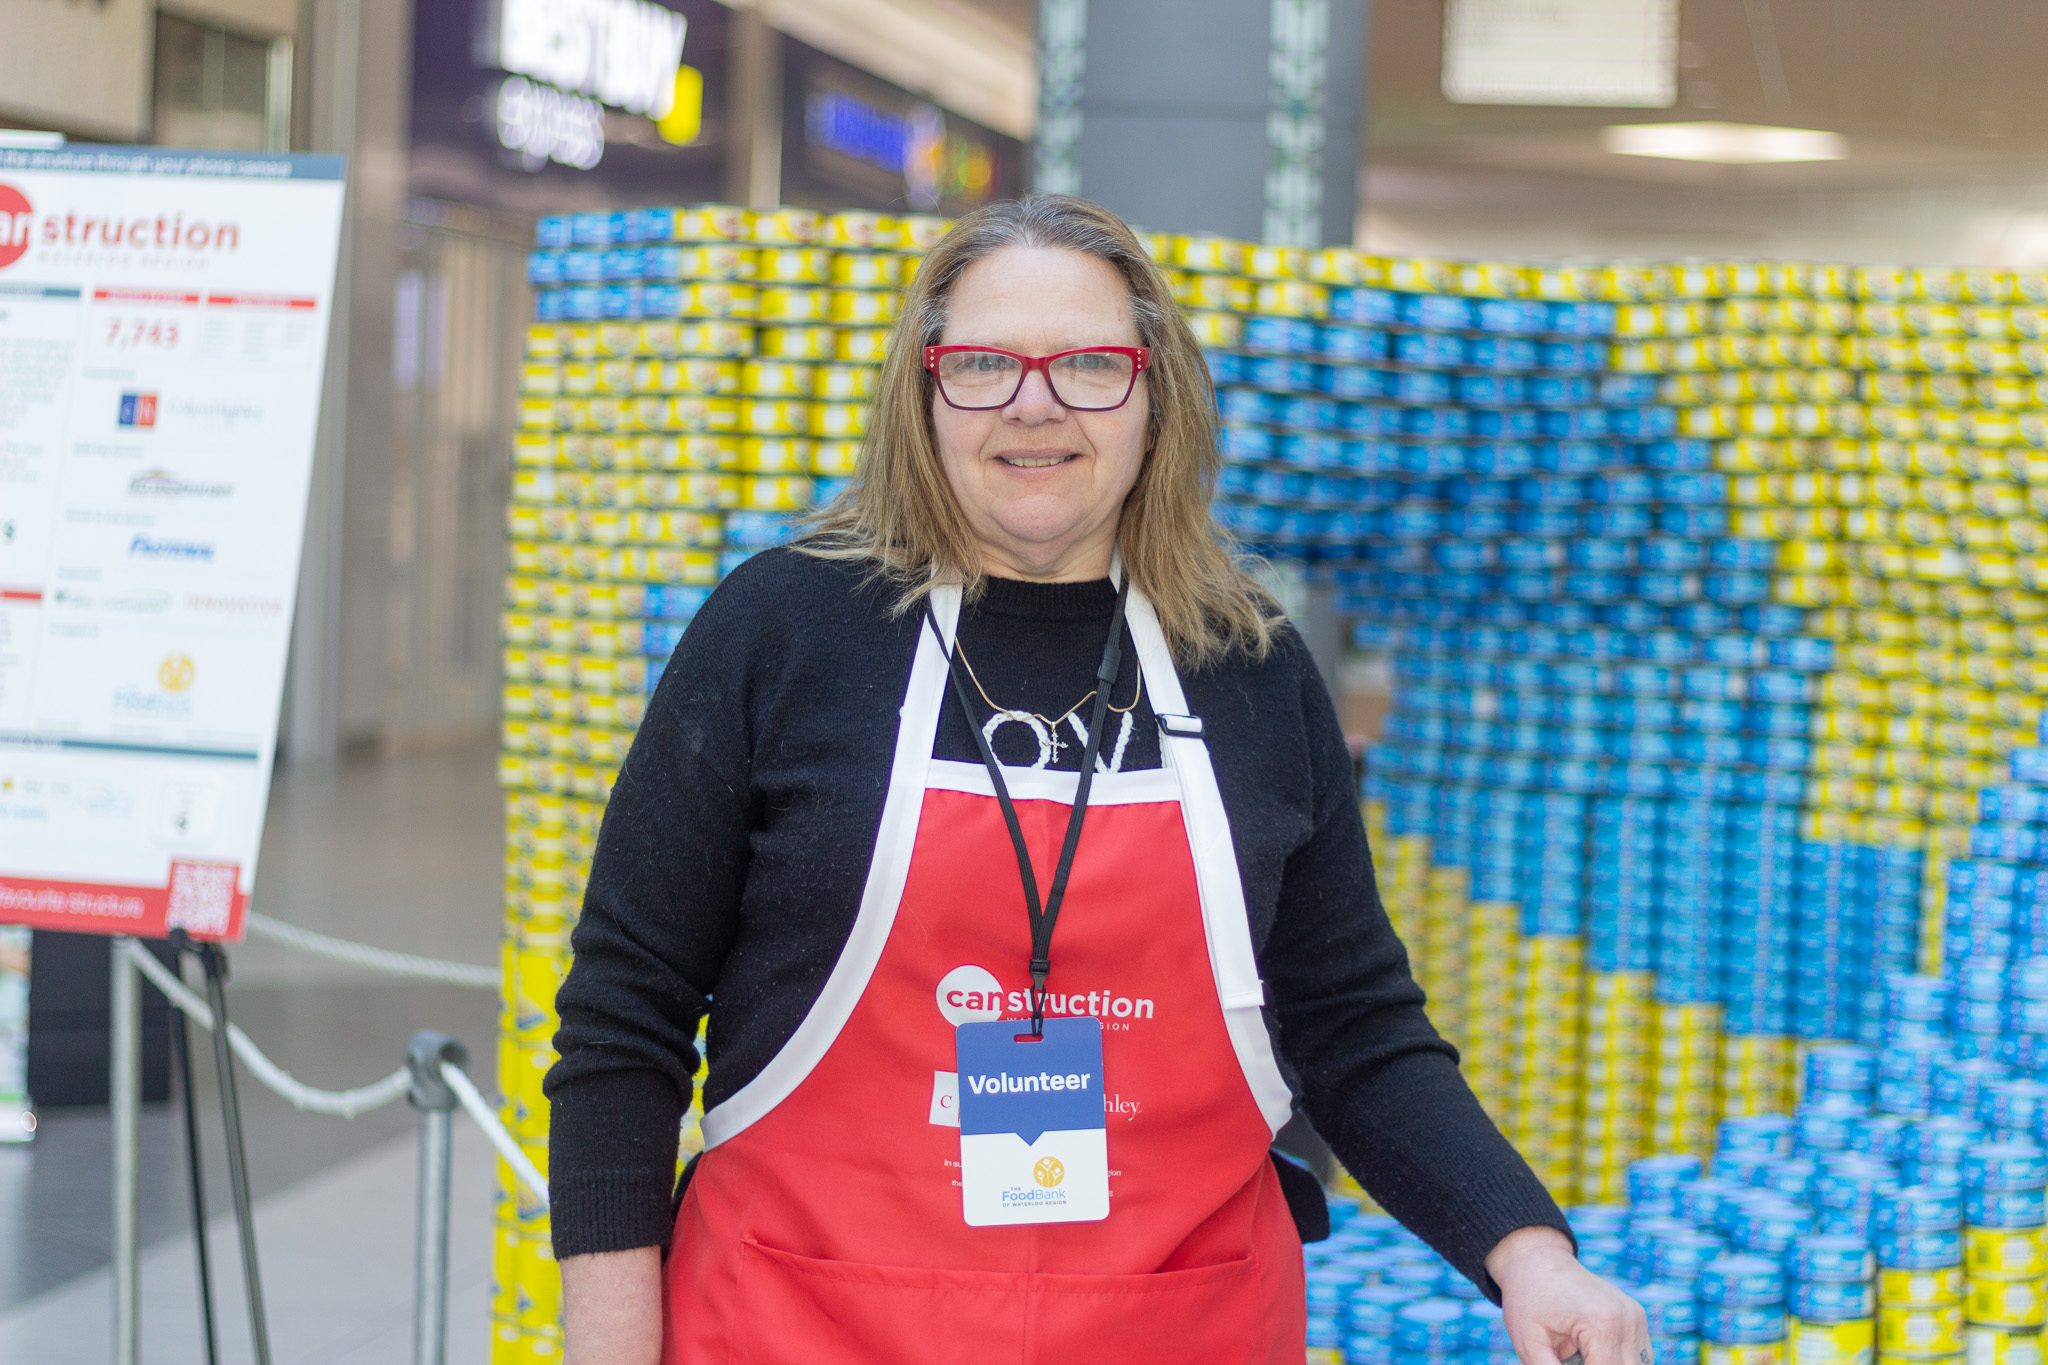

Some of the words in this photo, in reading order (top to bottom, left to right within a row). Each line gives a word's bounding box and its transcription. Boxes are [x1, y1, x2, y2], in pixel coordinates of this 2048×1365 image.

[945, 987, 1155, 1019] canstruction
[967, 1072, 1091, 1095] Volunteer
[1002, 1188, 1066, 1202] FoodBank
